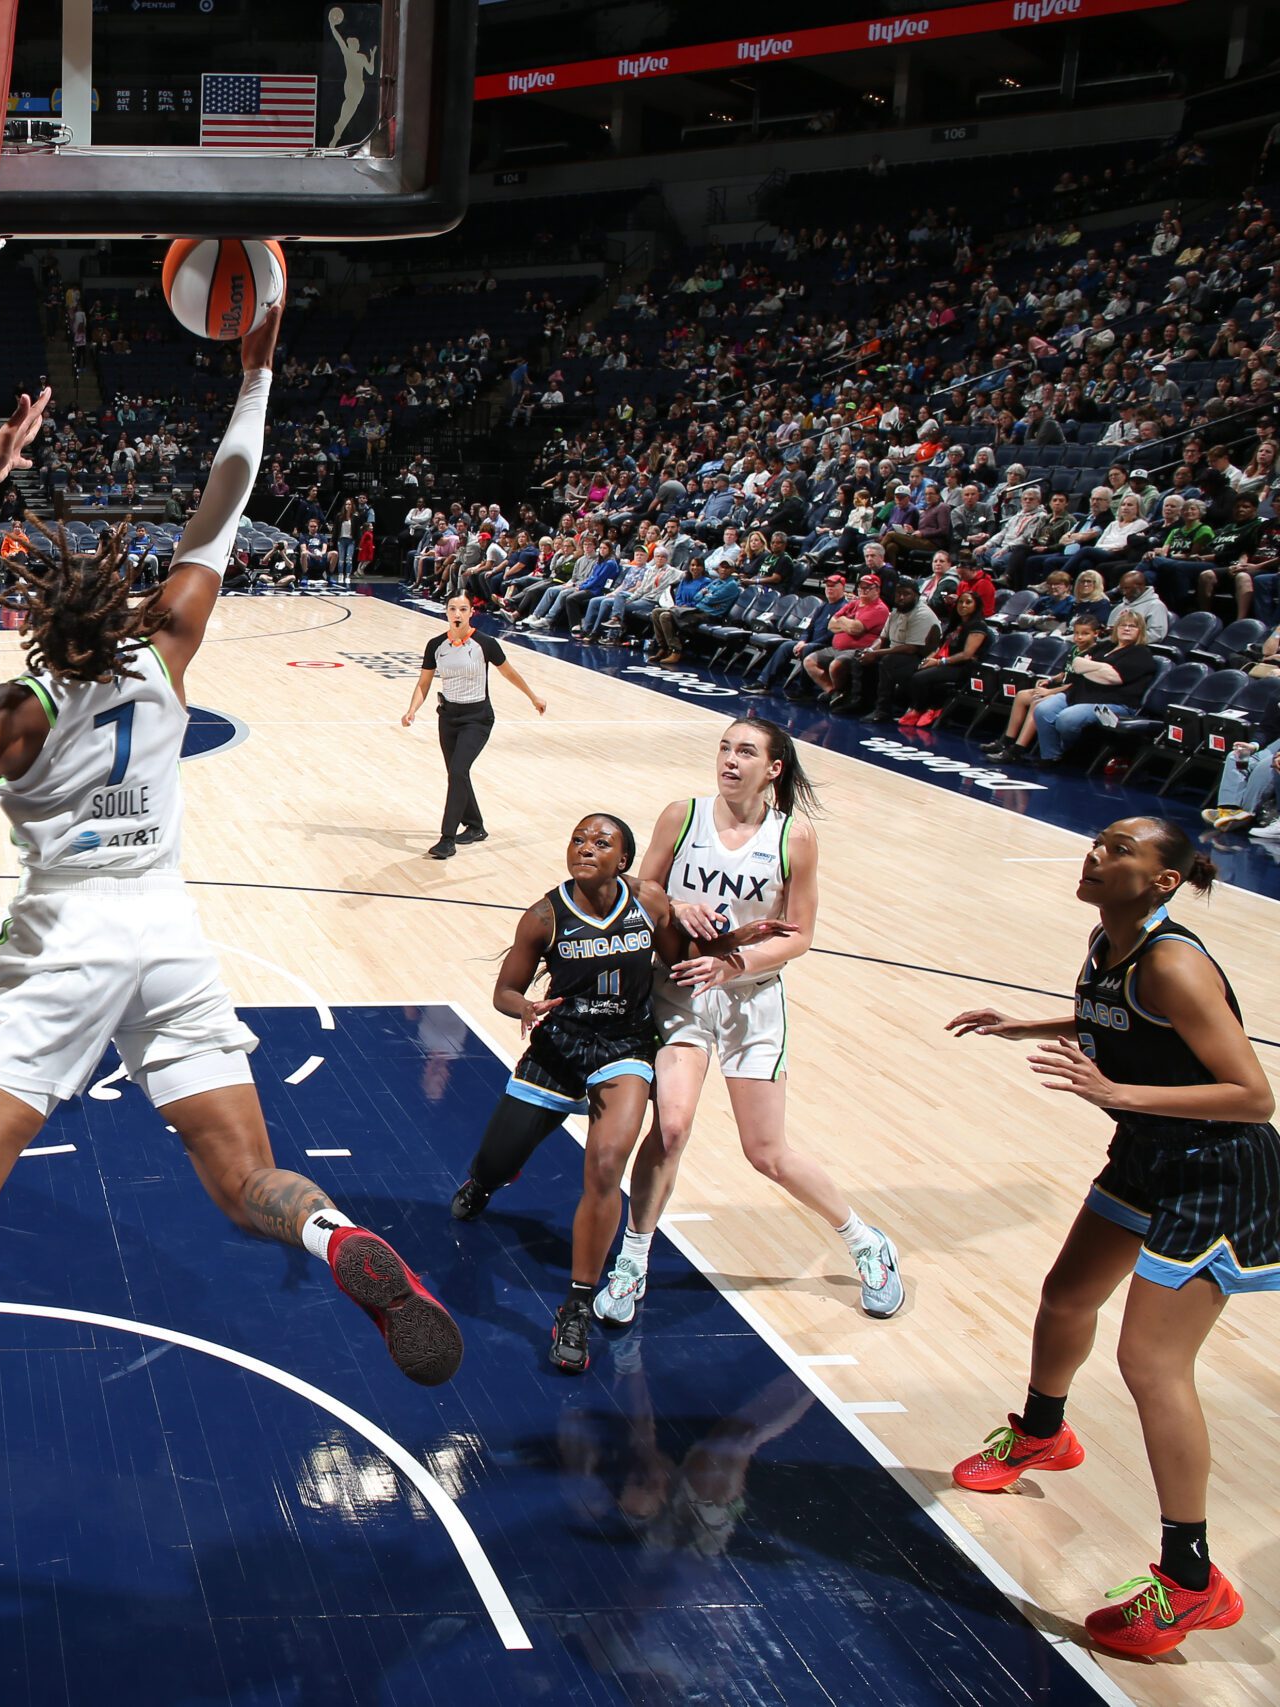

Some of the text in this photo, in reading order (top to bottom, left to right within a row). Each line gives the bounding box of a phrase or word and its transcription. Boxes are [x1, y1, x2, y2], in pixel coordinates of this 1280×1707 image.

[944, 128, 966, 140] 106
[502, 174, 519, 184] 104
[93, 699, 136, 787] 7
[92, 786, 150, 819] SOULE
[107, 827, 160, 848] AT&T
[682, 863, 770, 902] LYNX
[557, 930, 652, 960] CHICAGO
[597, 968, 621, 996] 11
